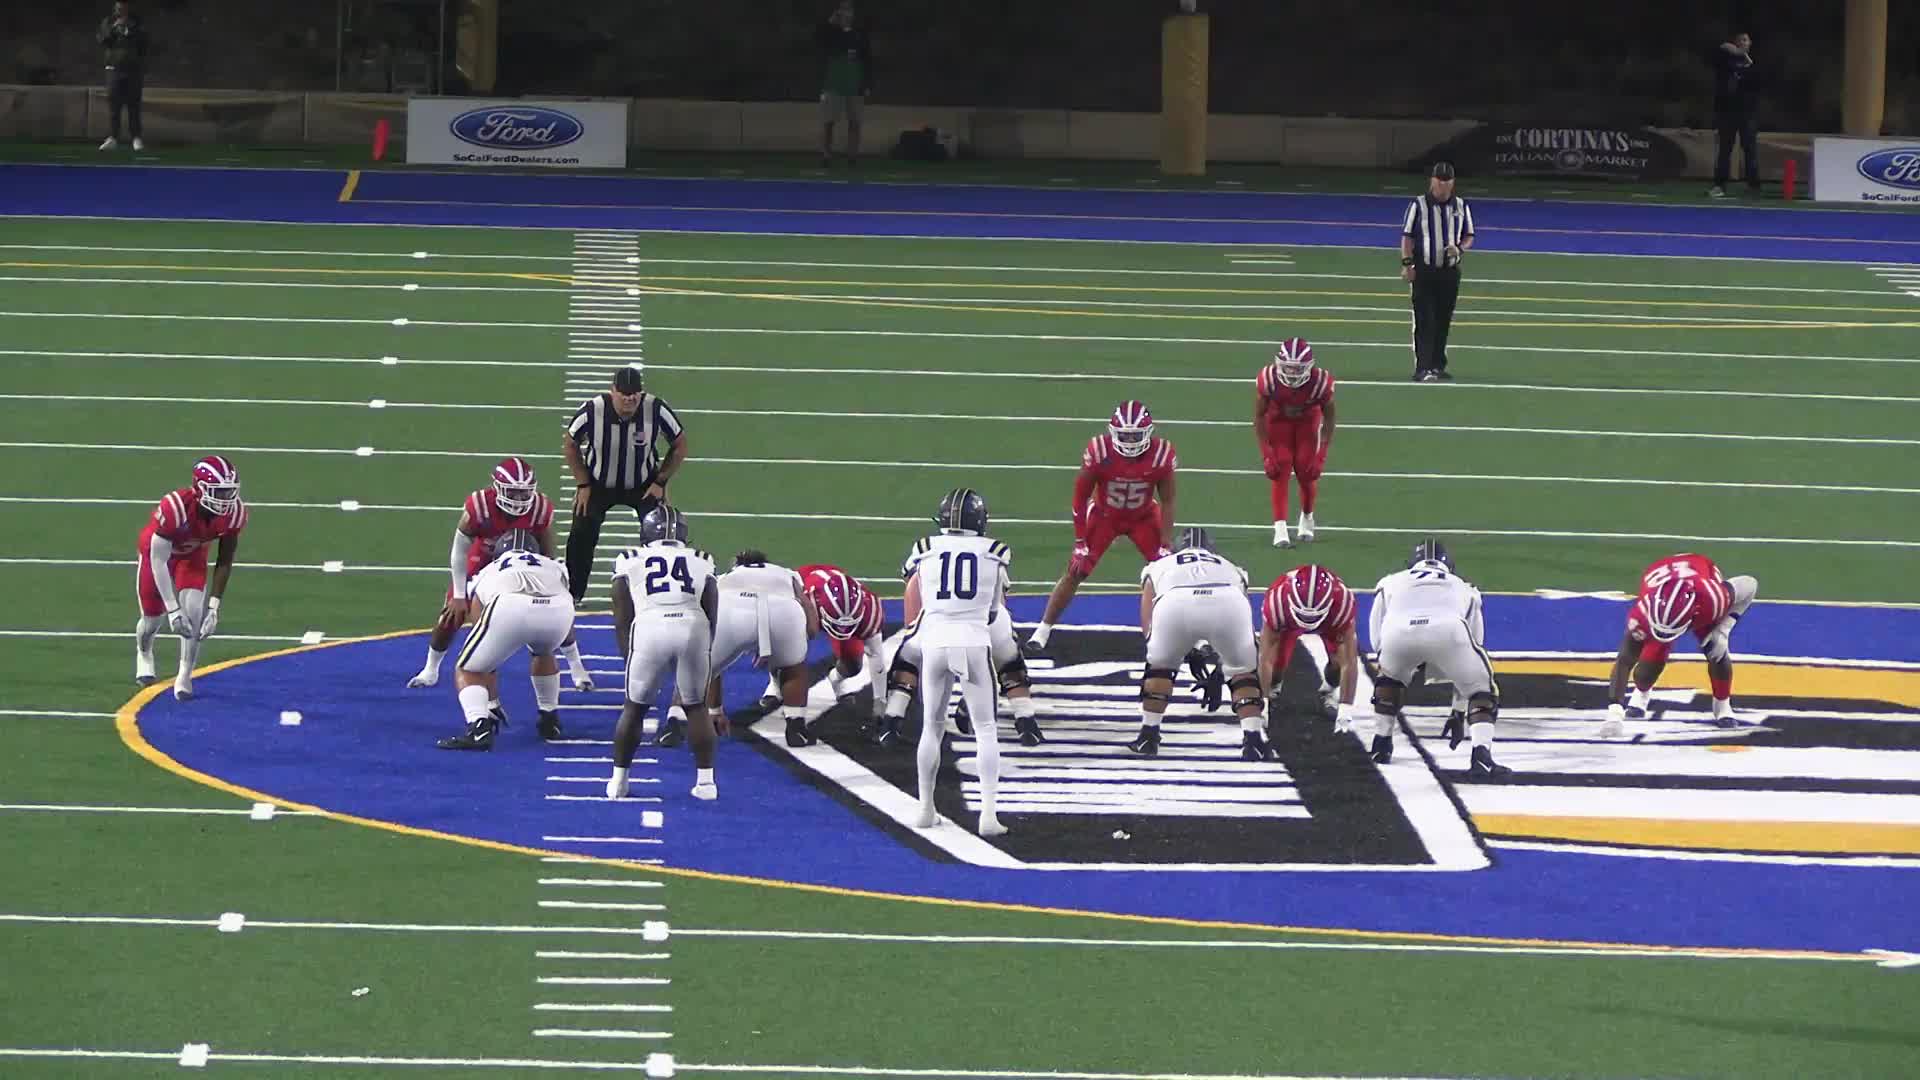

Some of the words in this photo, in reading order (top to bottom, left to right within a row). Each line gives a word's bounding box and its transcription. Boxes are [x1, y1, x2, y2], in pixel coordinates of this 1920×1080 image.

[476, 111, 556, 142] Ford
[1514, 128, 1630, 152] CORTINA'S
[453, 153, 579, 164] SoCalFordDealers.com
[1495, 152, 1554, 163] ITALIAN
[1584, 153, 1648, 168] MARKET
[1107, 480, 1151, 509] 55
[645, 555, 695, 595] 24
[936, 551, 979, 600] 10
